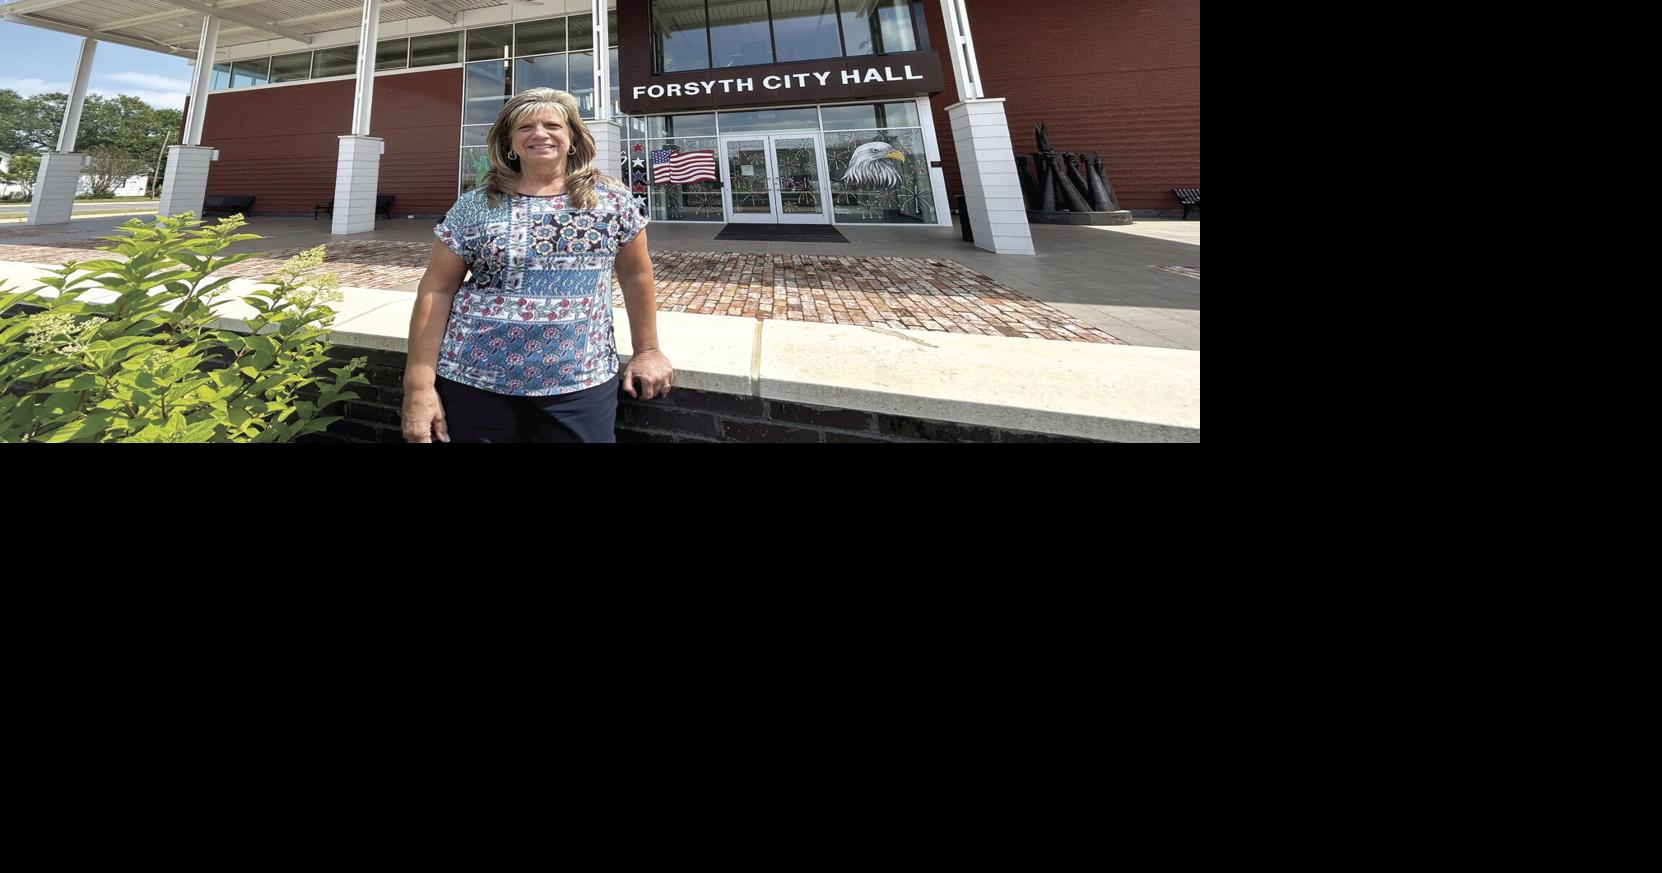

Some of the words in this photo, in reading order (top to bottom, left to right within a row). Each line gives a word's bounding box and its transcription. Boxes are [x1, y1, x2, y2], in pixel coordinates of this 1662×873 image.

[633, 77, 754, 99] FORSYTH
[762, 71, 831, 90] CITY
[840, 65, 924, 85] HALL
